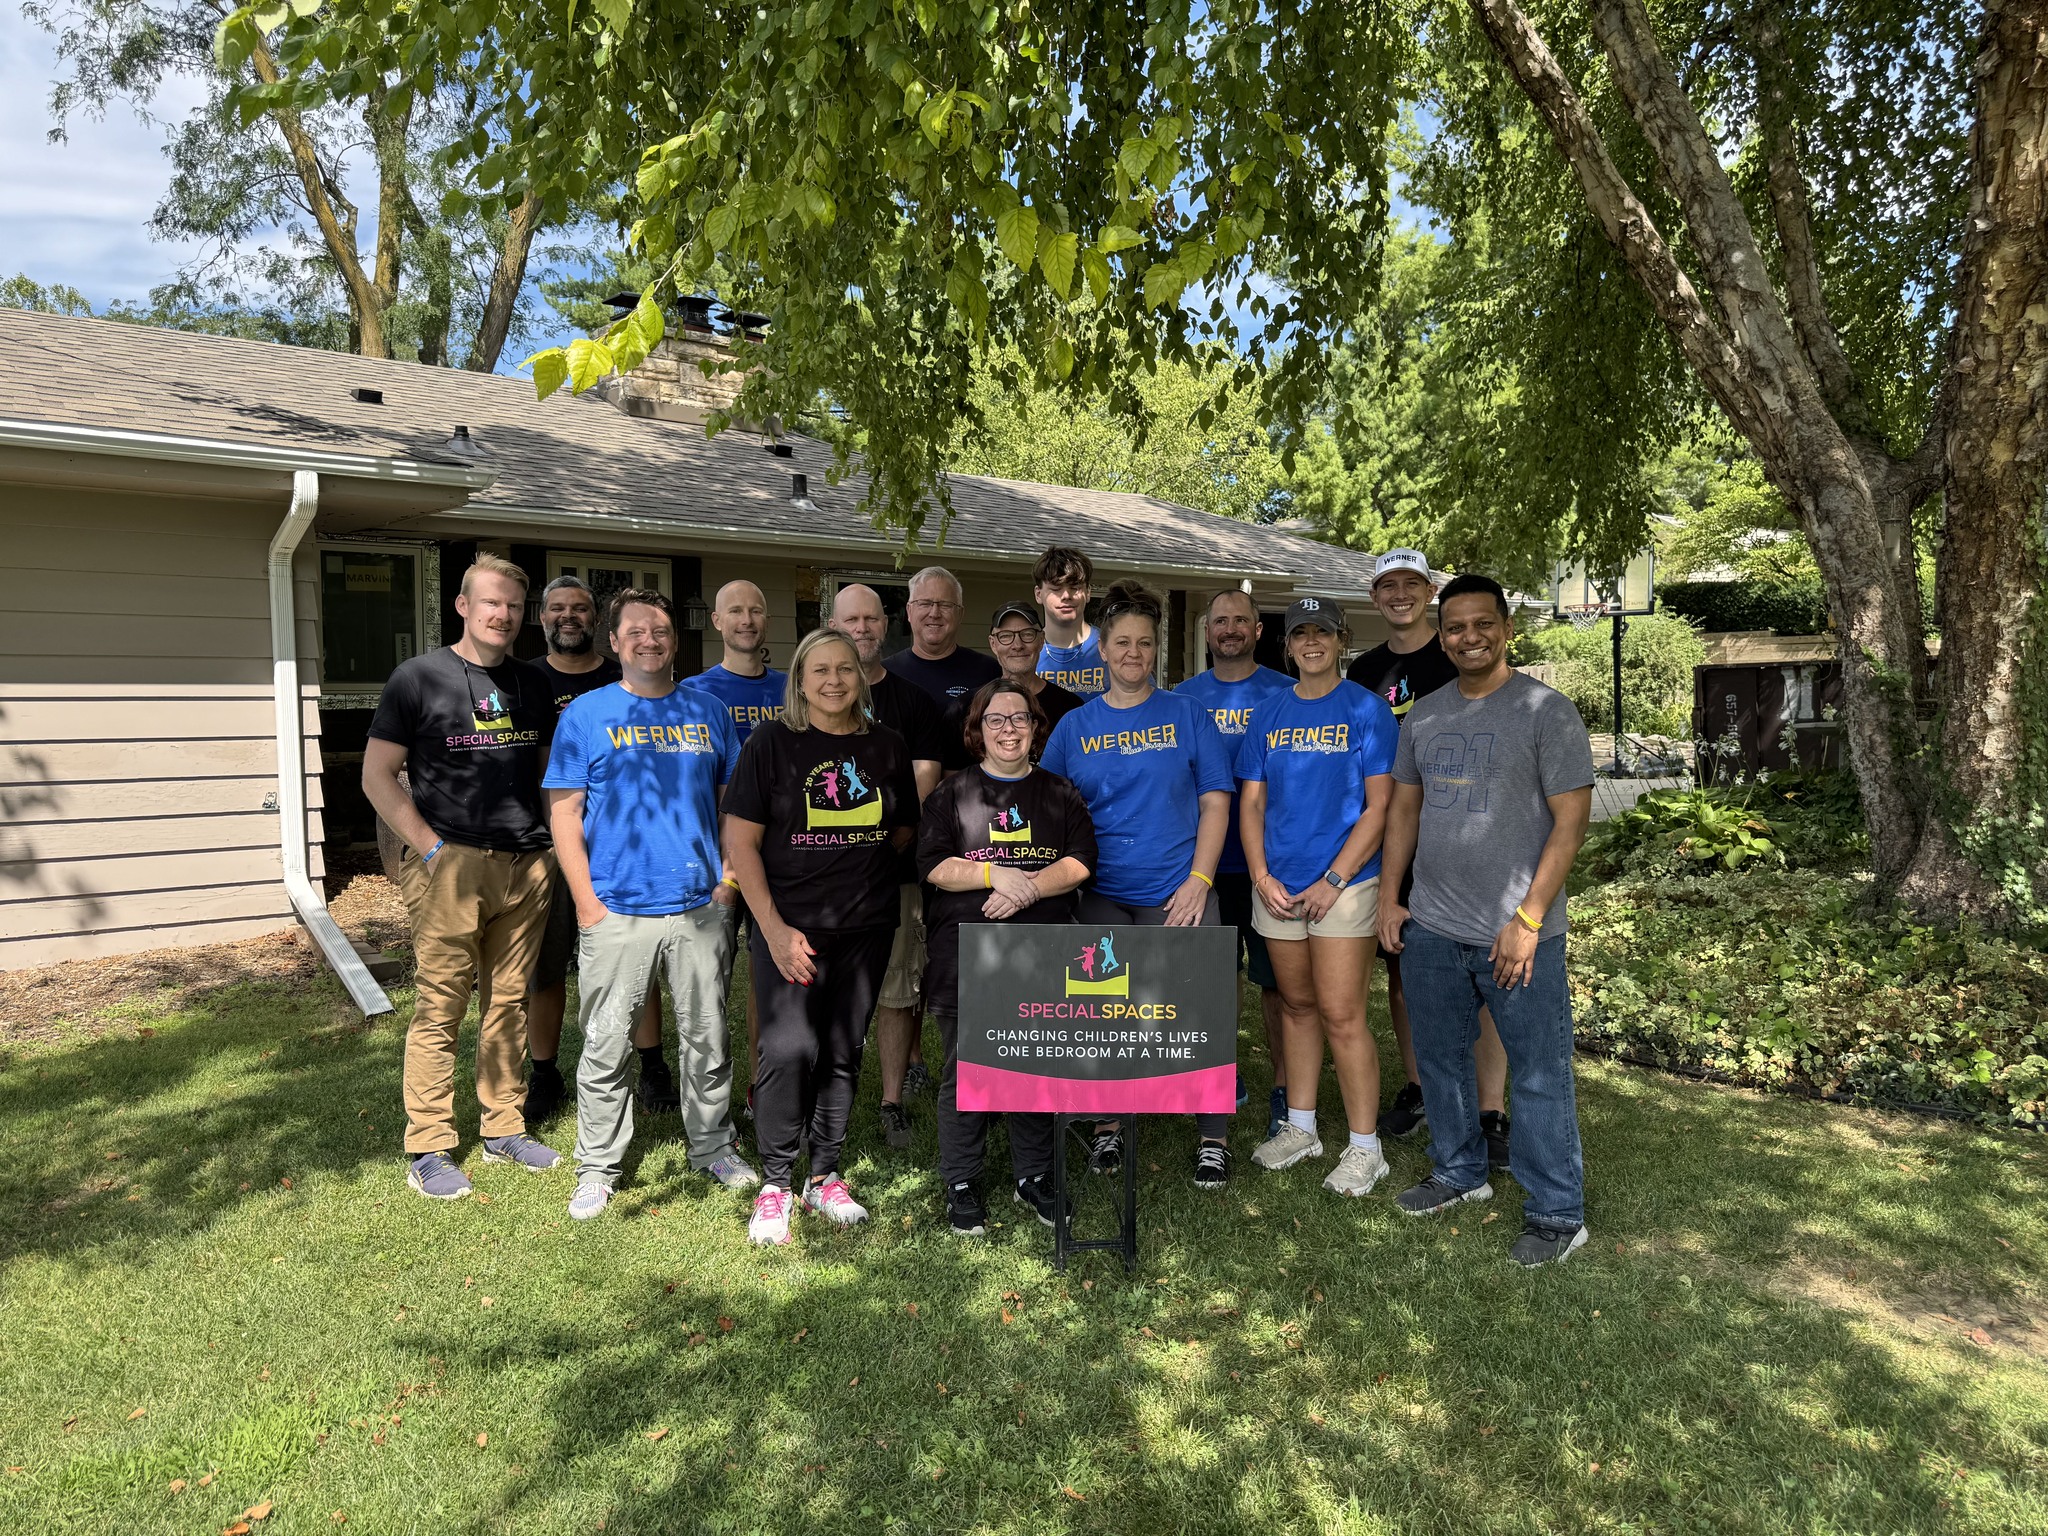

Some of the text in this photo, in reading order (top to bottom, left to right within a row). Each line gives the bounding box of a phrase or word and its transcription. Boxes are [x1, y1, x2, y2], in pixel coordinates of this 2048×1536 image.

[1383, 554, 1417, 565] WERNER
[346, 573, 391, 583] MARVIN
[1300, 598, 1320, 611] TB
[761, 647, 772, 664] 2
[606, 724, 714, 749] WERNER
[1080, 723, 1177, 754] WERNER
[809, 760, 835, 776] YEARS
[986, 1029, 1208, 1043] CHANGING CHILDREN'S LIVES
[997, 1045, 1196, 1059] ONE BEDROOM AT A TIME.
